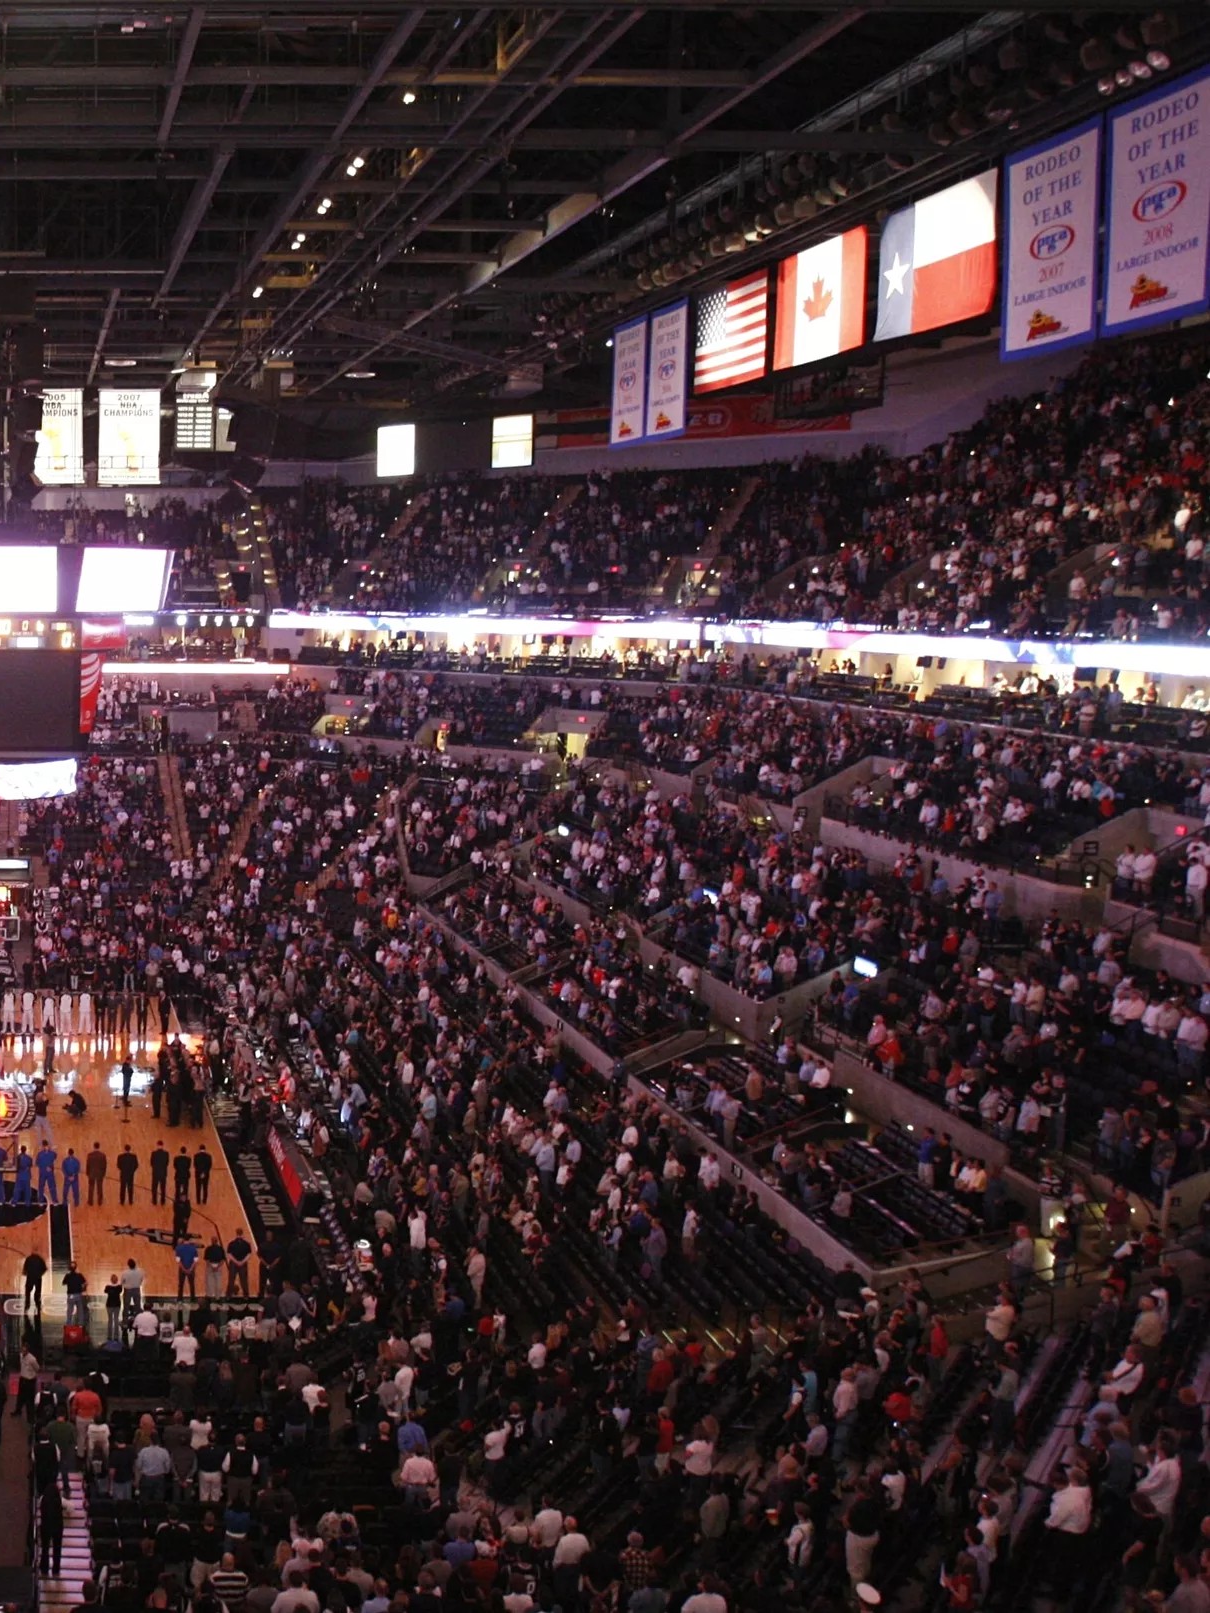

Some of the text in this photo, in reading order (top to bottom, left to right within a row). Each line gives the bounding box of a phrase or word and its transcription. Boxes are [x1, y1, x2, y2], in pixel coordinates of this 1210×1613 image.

[1131, 92, 1199, 134] RODEO
[1128, 119, 1199, 161] OF THE
[1025, 145, 1081, 181] RODEO
[1138, 153, 1185, 184] YEAR
[1023, 170, 1082, 206] OF THE
[1032, 200, 1073, 226] YEAR
[1116, 236, 1199, 272] LARGE INDOOR
[1014, 276, 1087, 306] LARGE INDOOR
[42, 409, 78, 417] AMPIONS
[104, 409, 154, 417] CHAMPIONS
[236, 1152, 287, 1227] spurs.com
